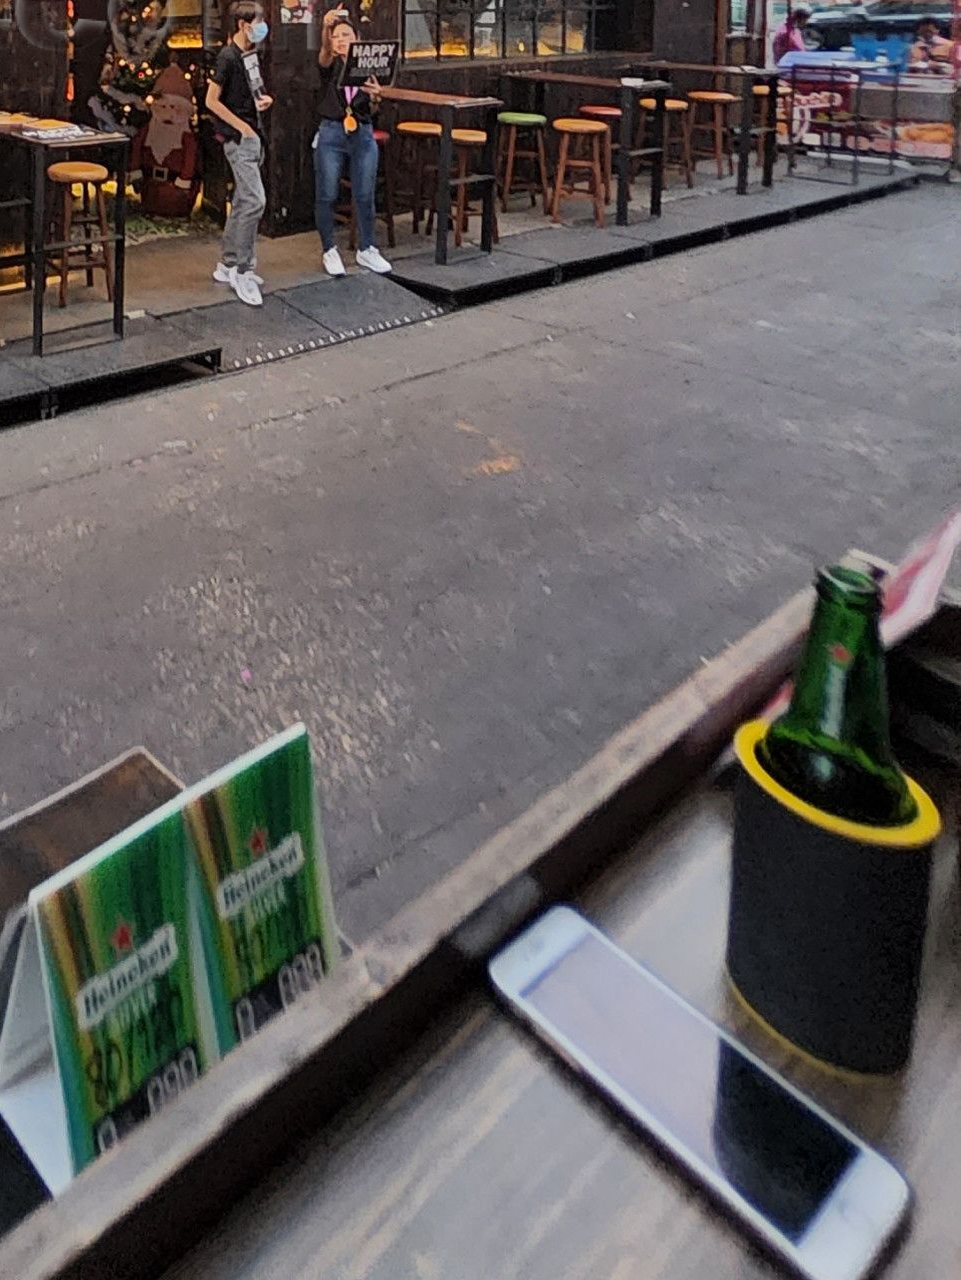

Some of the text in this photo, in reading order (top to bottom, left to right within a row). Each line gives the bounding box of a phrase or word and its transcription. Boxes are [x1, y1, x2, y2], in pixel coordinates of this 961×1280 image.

[352, 43, 395, 57] HAPPY
[358, 56, 389, 68] HOUR
[222, 845, 298, 910] Heineken
[83, 933, 172, 1018] Heineken
